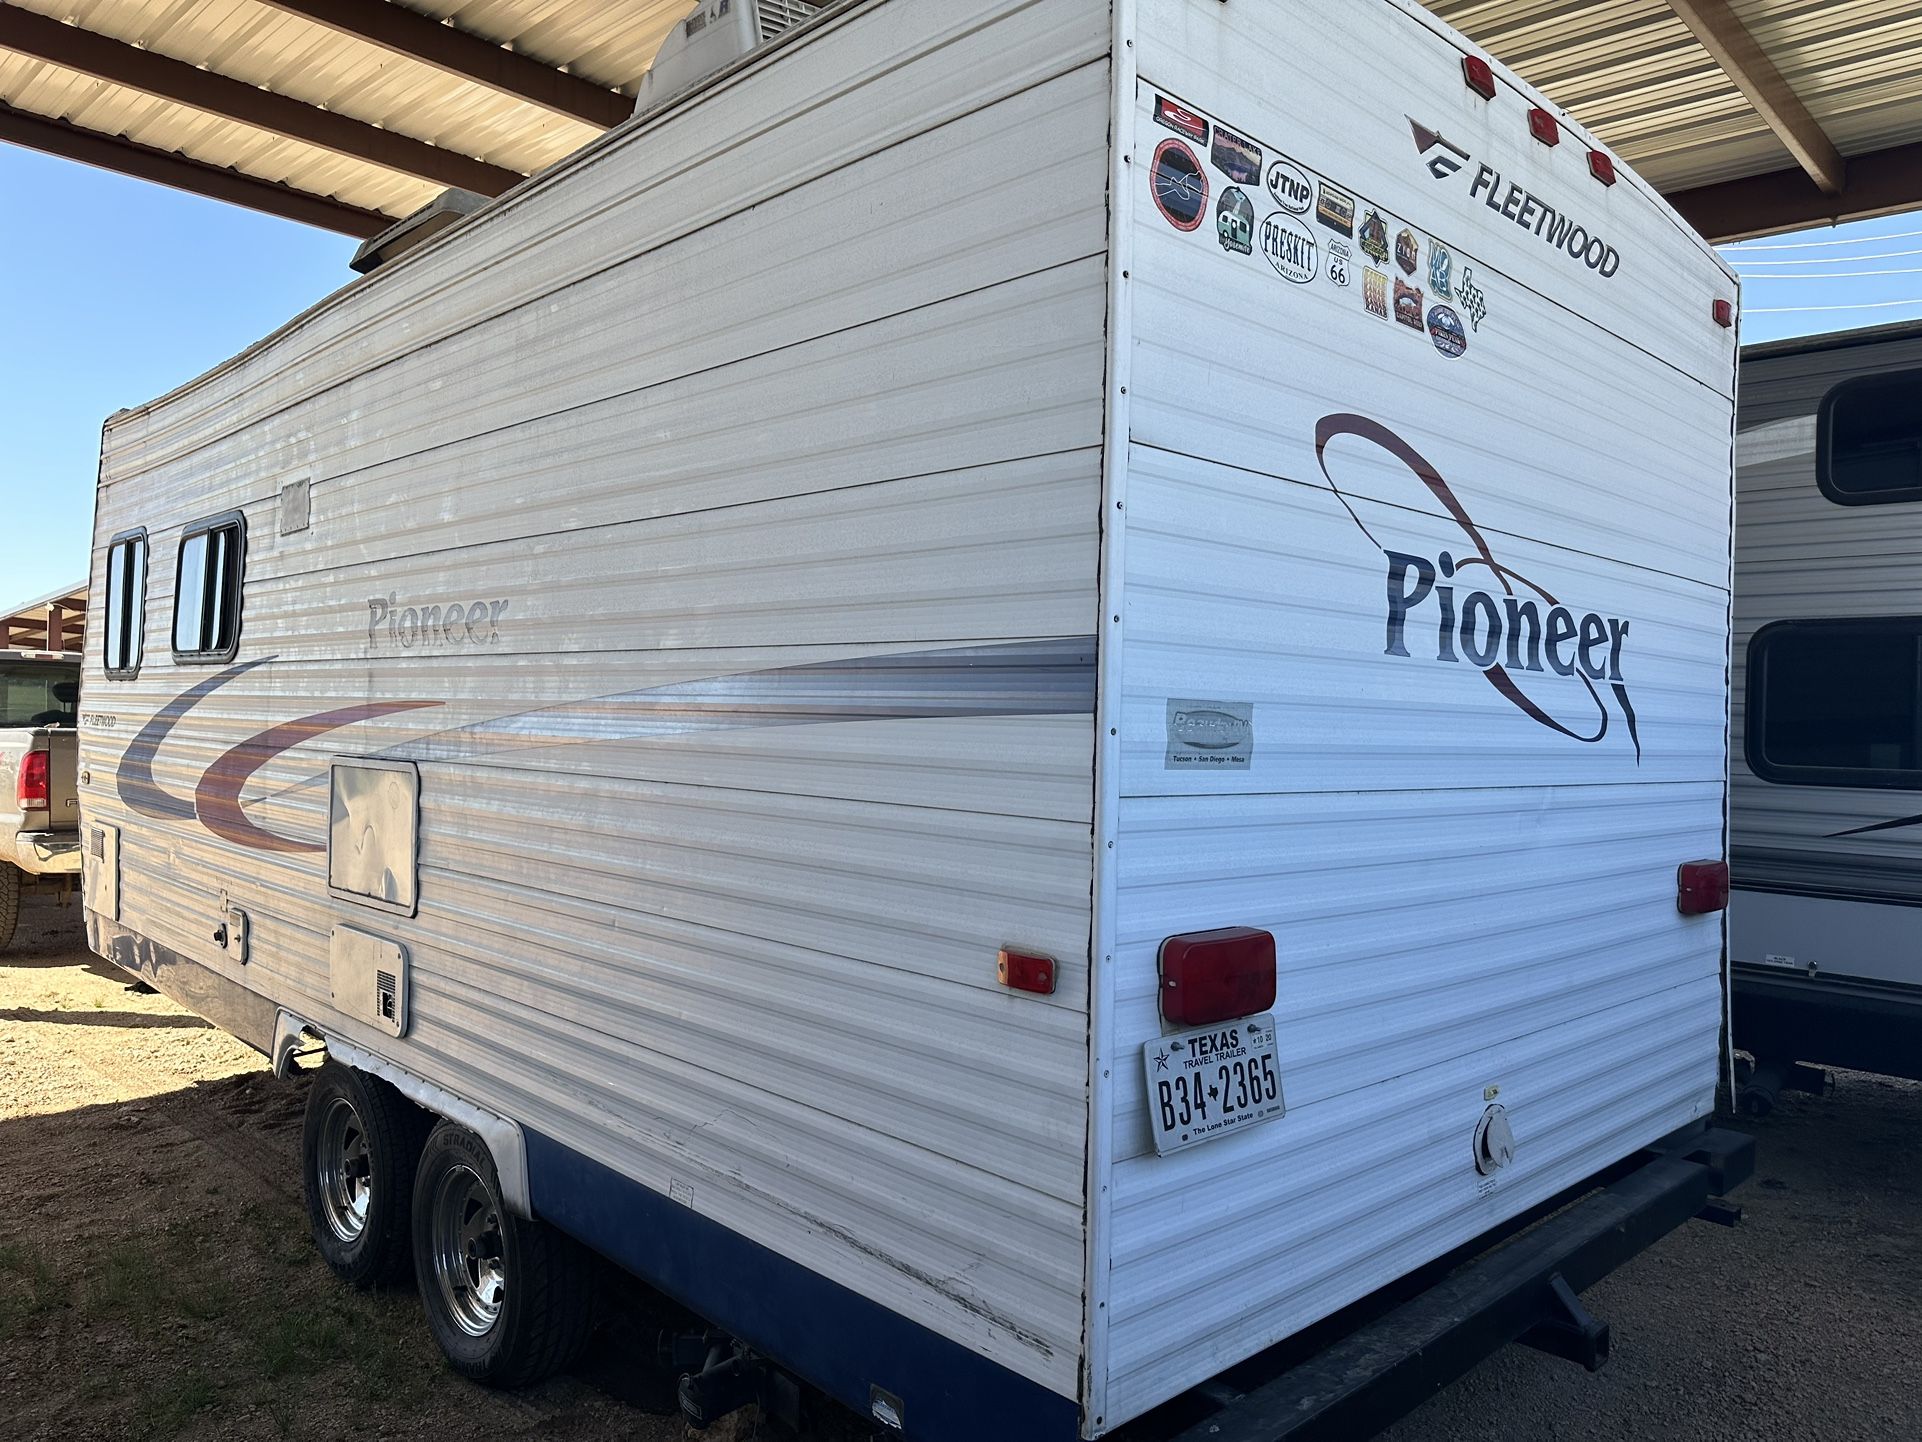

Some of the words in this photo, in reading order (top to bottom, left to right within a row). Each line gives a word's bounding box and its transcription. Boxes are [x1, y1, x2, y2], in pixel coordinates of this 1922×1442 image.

[1270, 171, 1310, 203] JTNP
[1469, 161, 1620, 278] FLEETWOOD
[1264, 220, 1314, 272] PRESKIT
[1330, 243, 1349, 257] ARIZONA
[1275, 261, 1309, 280] ARIZONA
[1330, 264, 1346, 284] 66
[1333, 257, 1343, 265] US
[368, 591, 509, 649] Pioneer
[1383, 550, 1630, 682] Pioneer
[1173, 755, 1192, 763] Tucson
[1198, 755, 1209, 763] San
[1210, 755, 1225, 764] Diego
[1231, 755, 1245, 763] Mesa
[1188, 1029, 1239, 1058] TEXAS
[1183, 1057, 1214, 1070] TRAVEL
[1215, 1047, 1247, 1062] TRAILER
[1158, 1071, 1207, 1132] B34
[1218, 1053, 1277, 1114] 2365
[1193, 1127, 1206, 1136] The
[1207, 1122, 1222, 1132] Lone
[1223, 1116, 1236, 1126] Star
[1237, 1112, 1254, 1122] State
